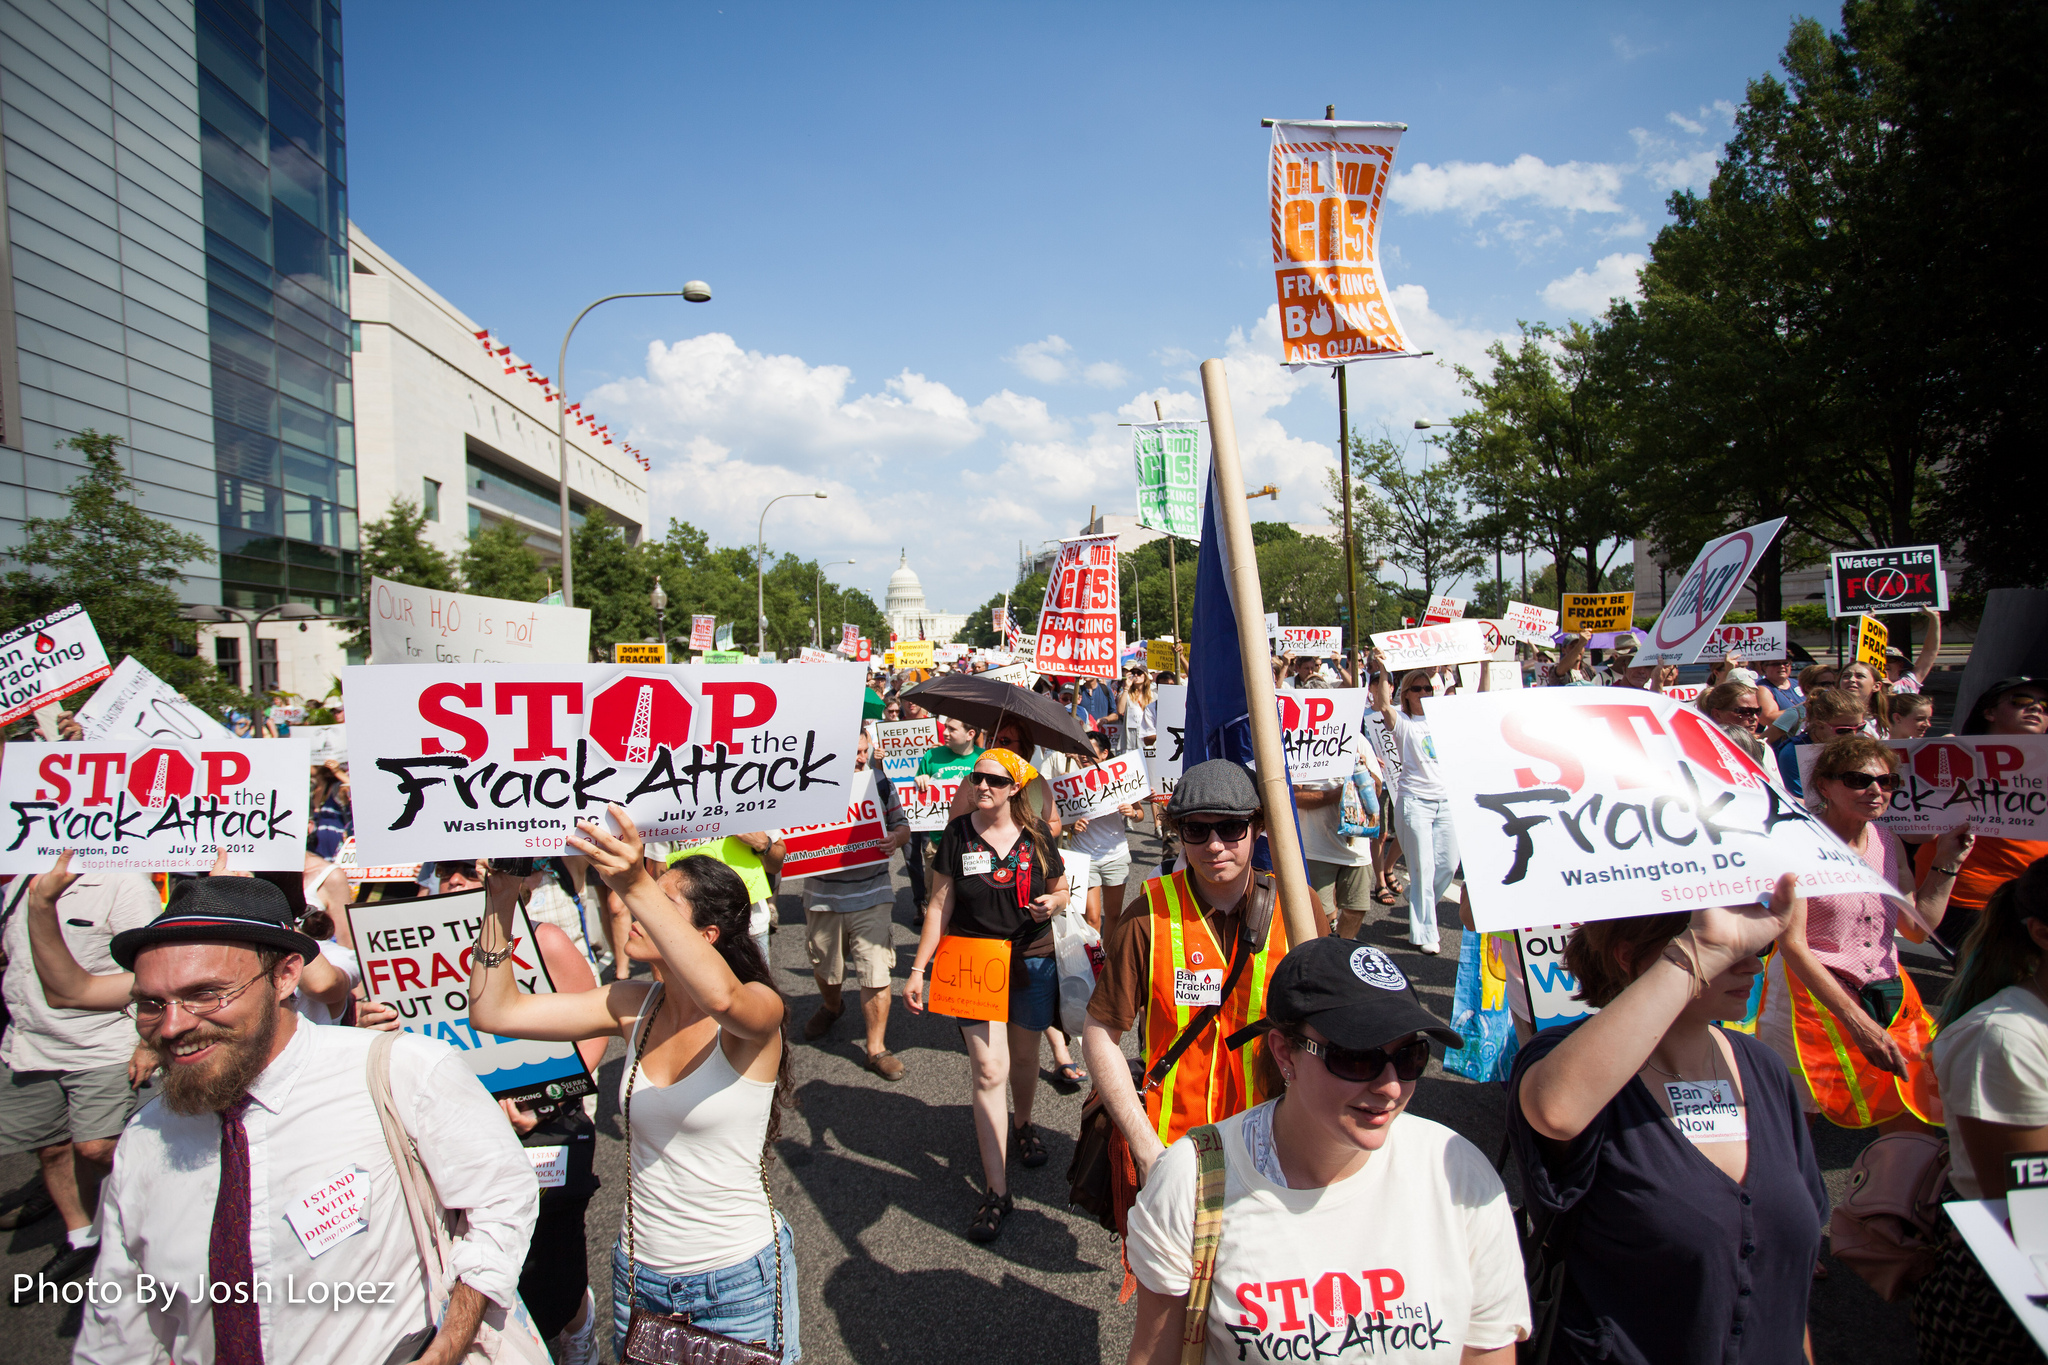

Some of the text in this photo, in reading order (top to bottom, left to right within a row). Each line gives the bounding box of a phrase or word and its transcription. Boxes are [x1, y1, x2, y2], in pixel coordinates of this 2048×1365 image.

[1284, 198, 1367, 263] GAS
[1283, 274, 1376, 298] FRACKING
[1290, 334, 1406, 363] AIR QUALITY
[1144, 454, 1191, 486] GAS
[1142, 490, 1195, 503] FRACKING
[1839, 556, 1884, 569] Water
[1902, 552, 1932, 565] Life
[1055, 568, 1109, 610] GAS
[1847, 573, 1932, 598] FRACK
[1440, 598, 1455, 607] BAN
[1572, 596, 1625, 606] DON'T BE
[26, 603, 82, 632] TO 69866
[377, 585, 415, 627] OUR
[478, 613, 493, 635] is
[506, 612, 539, 642] not
[1427, 606, 1463, 618] FRACKING
[1523, 606, 1542, 617] BAN
[1568, 605, 1629, 618] FRACKIN'
[1045, 616, 1113, 634] FRACKING
[1579, 619, 1616, 629] CRAZY
[1284, 629, 1332, 642] STOP
[1386, 627, 1459, 649] STOP
[1706, 626, 1764, 644] TOP
[406, 637, 423, 658] For
[436, 644, 461, 663] Gas
[622, 646, 659, 654] DON'T BE
[1702, 636, 1783, 654] ack Attack
[0, 649, 24, 671] an
[0, 642, 86, 690] racking
[620, 655, 664, 664] FRACKIN'
[1039, 660, 1114, 677] OUR HEALTH
[1004, 672, 1022, 681] THE
[418, 676, 778, 764] STOP
[1322, 723, 1340, 735] the
[883, 726, 931, 737] KEEP THE
[751, 731, 798, 754] the
[881, 735, 935, 749] FRACK
[1284, 723, 1352, 762] Attack
[884, 748, 919, 758] OUT OF
[1313, 760, 1330, 768] 2012
[36, 747, 251, 808] STOP
[376, 730, 840, 831] Frack Attack
[1053, 761, 1128, 800] STOP
[2012, 773, 2043, 789] the
[234, 788, 266, 806] the
[898, 784, 961, 807] TOP
[1056, 788, 1099, 818] Frack
[1101, 770, 1148, 802] Attack
[1943, 778, 2048, 815] Attac
[6, 789, 297, 850] Frack Attack
[443, 817, 567, 833] Washington,
[658, 809, 697, 823] July
[702, 805, 729, 817] 28,
[735, 799, 777, 814] 2012
[1474, 760, 1769, 886] Frack
[1966, 814, 1986, 824] July
[1989, 815, 2005, 826] 28,
[2008, 817, 2035, 826] 2012
[112, 845, 129, 855] DC
[168, 844, 197, 855] July
[227, 844, 255, 853] 2012
[82, 858, 217, 870] stopthefrackattack.org
[1560, 857, 1707, 887] Washington,
[1713, 852, 1746, 870] DC
[366, 917, 484, 954] KEEP TH
[1526, 935, 1569, 957] OU
[1176, 970, 1197, 982] Ban
[1175, 981, 1221, 992] Fracking
[1175, 990, 1200, 1001] Now
[933, 993, 1000, 1011] causes reproductive
[560, 1079, 588, 1090] SIERRA
[565, 1084, 588, 1094] CLUB
[1667, 1086, 1703, 1101] Ban
[1672, 1100, 1738, 1117] Fracking
[1677, 1118, 1715, 1132] Now
[536, 1151, 560, 1159] STAND
[555, 1169, 566, 1177] PA
[302, 1173, 355, 1209] I STAND
[317, 1189, 356, 1216] WITH
[304, 1202, 359, 1242] DIMOCK
[1236, 1268, 1405, 1333] STOP
[1396, 1302, 1423, 1319] the
[1225, 1302, 1451, 1361] Frack Attack
